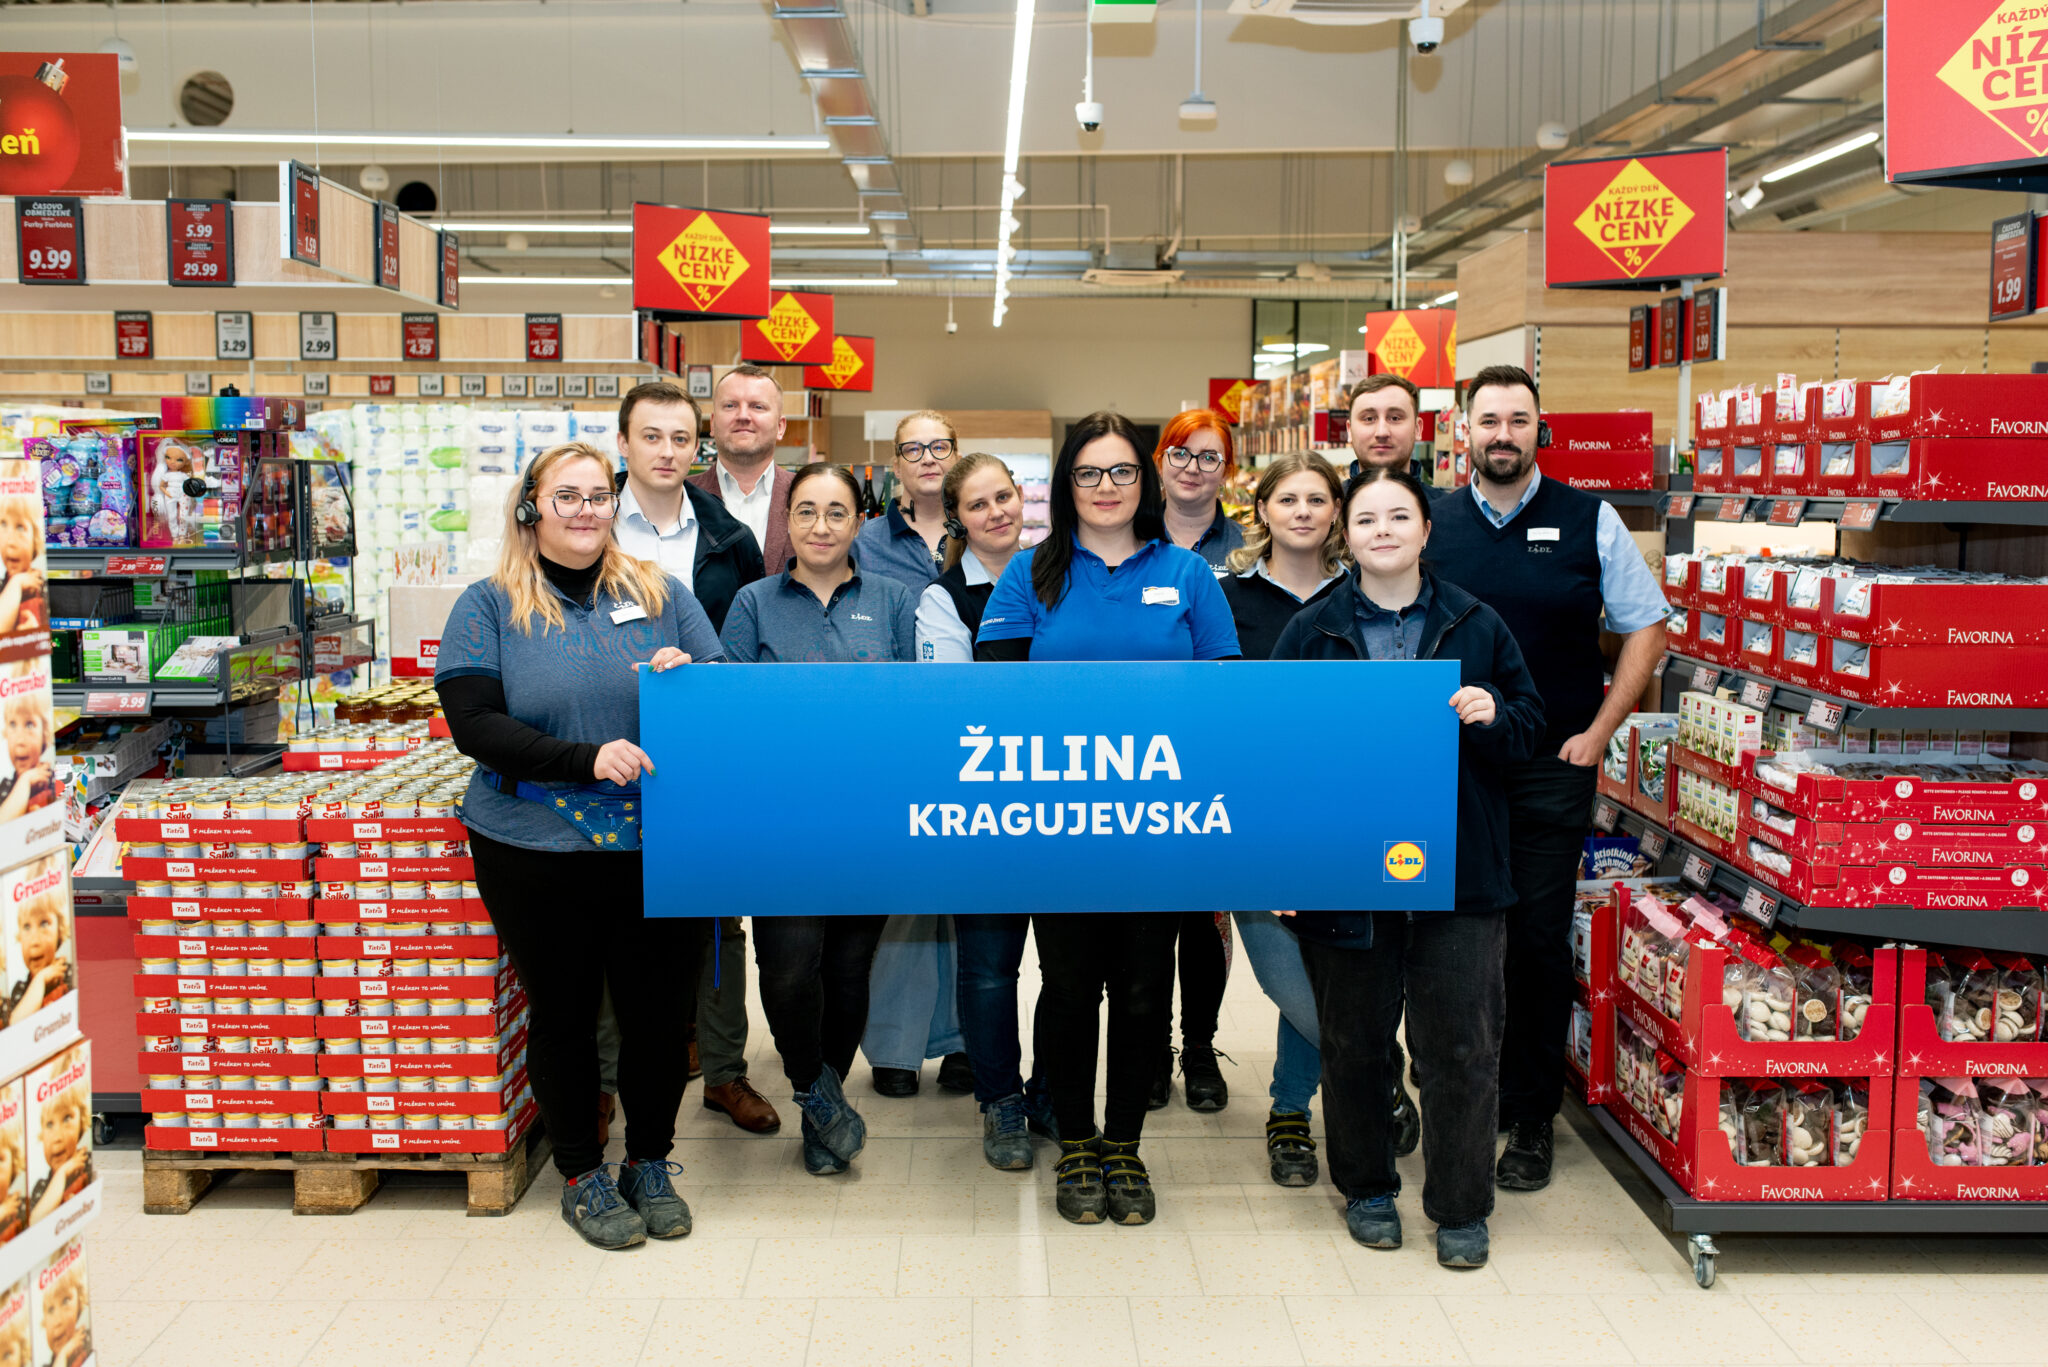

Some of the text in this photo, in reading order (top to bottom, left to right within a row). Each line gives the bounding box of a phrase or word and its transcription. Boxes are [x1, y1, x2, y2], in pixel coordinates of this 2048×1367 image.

[0, 128, 40, 155] eň
[1608, 183, 1660, 196] KAŽDÝ DEŇ
[1594, 197, 1675, 222] NÍZKE
[185, 223, 213, 238] 5.99
[684, 232, 708, 242] KAŽDÝ
[1599, 219, 1669, 243] CENY
[29, 249, 72, 270] 9.99
[673, 241, 735, 265] NÍZKE
[1623, 247, 1642, 267] %
[183, 262, 218, 277] 29.99
[384, 255, 398, 277] 3.29
[678, 262, 731, 282] CENY
[696, 285, 711, 302] %
[1996, 277, 2022, 305] 1.99
[768, 313, 809, 329] NÍZKE
[771, 327, 807, 340] CENY
[222, 340, 247, 352] 3.29
[305, 340, 331, 353] 2.99
[408, 343, 432, 355] 4.29
[532, 344, 556, 356] 4.69
[1384, 336, 1418, 350] NÍZKE
[1696, 333, 1709, 352] 1.99
[1386, 349, 1414, 364] CENY
[1880, 429, 1901, 440] FAVORINA
[1568, 439, 1611, 451] FAVORINA
[1568, 477, 1611, 488] FAVORINA
[1878, 487, 1899, 497] FAVORINA
[1732, 503, 1745, 516] 1.99
[1787, 506, 1800, 519] 1.99
[120, 563, 136, 571] 7.99
[149, 563, 165, 571] 7.99
[1841, 627, 1860, 640] FAVORINA
[1947, 628, 2015, 644] FAVORINA
[0, 672, 47, 698] Granko
[1840, 685, 1860, 699] FAVORINA
[119, 697, 146, 709] 9.99
[1755, 688, 1770, 704] 3.99
[1946, 689, 2013, 706] FAVORINA
[1824, 709, 1840, 725] 3.19
[957, 724, 1183, 783] ŽILINA
[1760, 784, 1785, 807] FAVORINA
[166, 812, 192, 820] Salko
[322, 811, 347, 819] Salko
[360, 810, 384, 818] Salko
[908, 793, 1234, 837] KRAGUJEVSKÁ
[1933, 805, 1996, 821] FAVORINA
[25, 819, 62, 845] Granko
[1758, 826, 1783, 849] FAVORINA
[209, 850, 234, 859] Salko
[439, 849, 463, 858] Salko
[1932, 848, 1994, 863] FAVORINA
[1696, 865, 1709, 881] 4.99
[1754, 865, 1780, 889] FAVORINA
[13, 870, 62, 903] Granko
[278, 890, 302, 899] Salko
[324, 891, 350, 900] Salko
[1926, 892, 1988, 907] FAVORINA
[1759, 902, 1775, 918] 4.99
[34, 1011, 72, 1043] Granko
[1632, 1000, 1665, 1044] FAVORINA
[153, 1044, 179, 1053] Salko
[253, 1046, 279, 1054] Salko
[1765, 1059, 1829, 1075] FAVORINA
[1965, 1060, 2029, 1076] FAVORINA
[37, 1060, 86, 1103] Granko
[1629, 1114, 1661, 1161] FAVORINA
[1761, 1184, 1825, 1200] FAVORINA
[1956, 1184, 2020, 1200] FAVORINA
[38, 1241, 82, 1291] Granko
